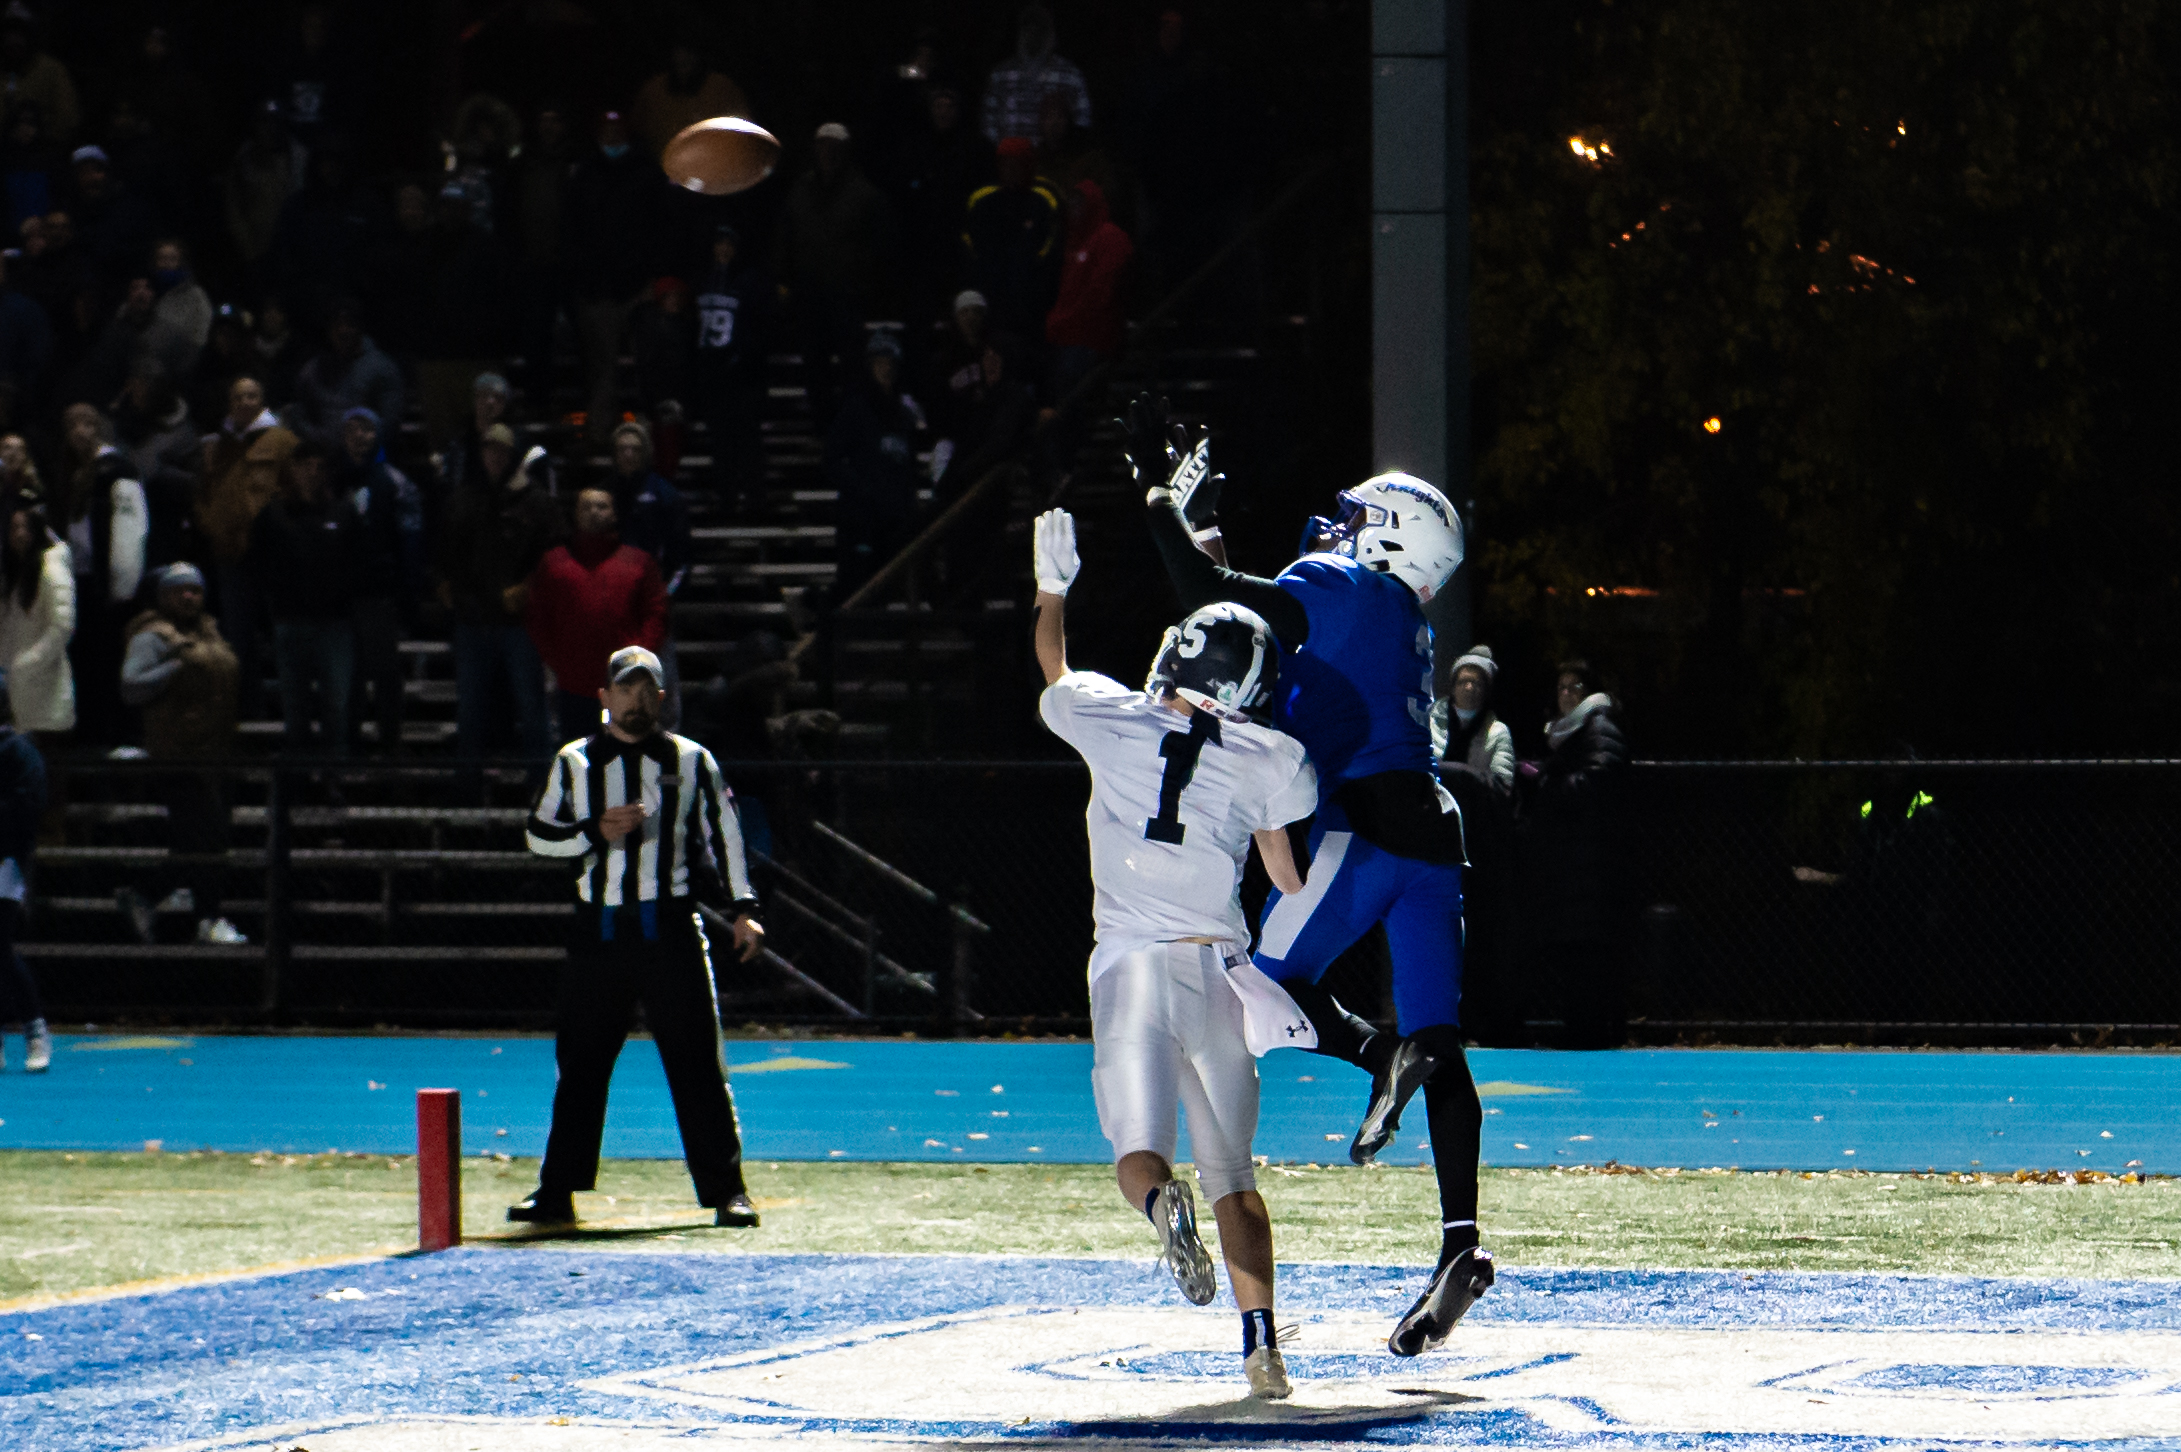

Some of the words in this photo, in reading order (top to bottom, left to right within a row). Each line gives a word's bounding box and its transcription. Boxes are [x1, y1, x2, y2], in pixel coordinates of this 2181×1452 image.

[697, 308, 735, 347] 19
[1177, 613, 1217, 659] S
[1144, 720, 1204, 846] 1
